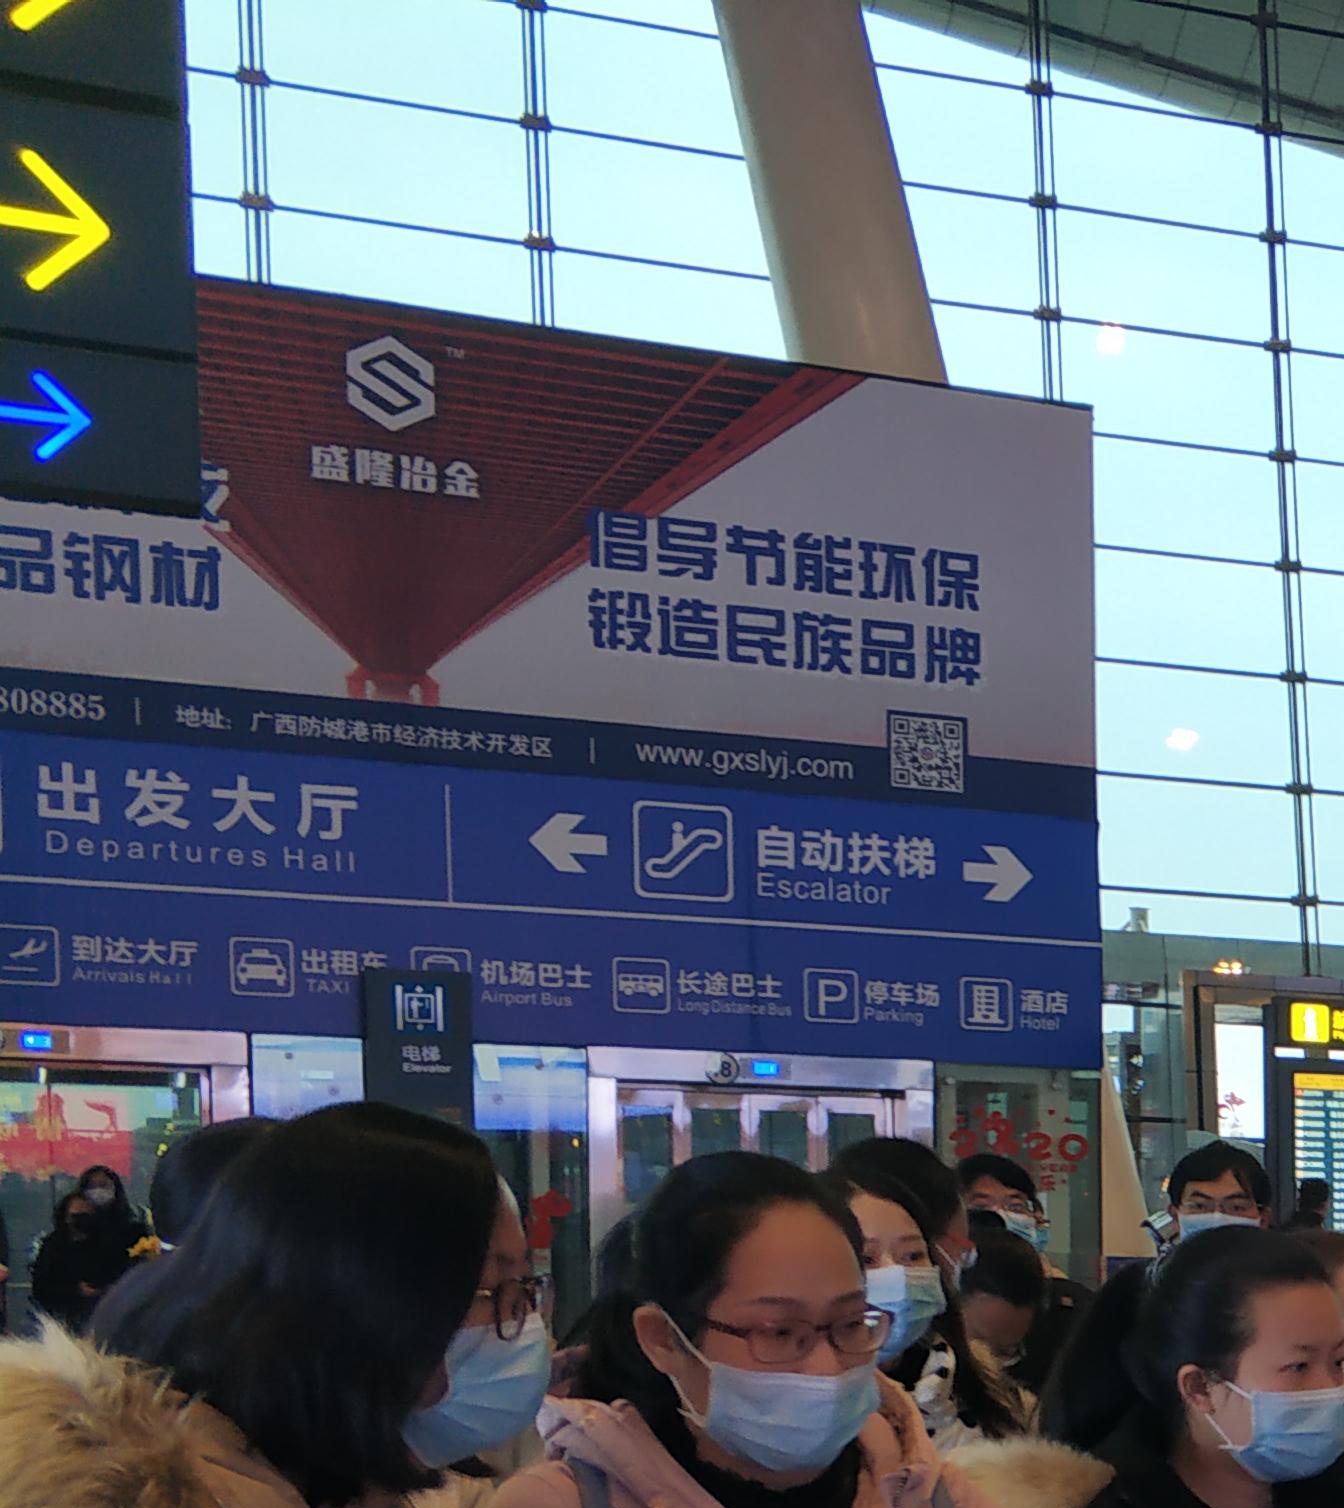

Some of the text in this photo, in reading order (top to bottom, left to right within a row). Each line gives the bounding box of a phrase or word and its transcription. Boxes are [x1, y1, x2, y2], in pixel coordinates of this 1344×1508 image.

[310, 444, 481, 499] 盛隆冶金
[0, 523, 222, 611] 品钢材
[588, 508, 981, 612] 倡导节能环保
[587, 588, 982, 687] 锻造民族品牌
[635, 741, 855, 781] www.gxslyj.com
[36, 760, 360, 841] 出发大厅
[45, 829, 357, 874] Departures Hall
[756, 824, 937, 880] 自动扶梯
[756, 873, 892, 906] Escalator
[71, 934, 200, 967] 到达大厅
[301, 948, 389, 977] 出租车
[72, 967, 193, 985] Arrivals Hall
[305, 977, 350, 995] TAXI
[479, 958, 593, 989] 机场巴士
[676, 969, 784, 1000] 长途巴士
[479, 990, 574, 1009] Airport Bus
[677, 999, 792, 1018] Long Distance Bus
[864, 980, 941, 1008] 停车场
[1019, 988, 1069, 1016] 酒店
[863, 1006, 925, 1027] Parking
[1019, 1015, 1061, 1032] Hotel
[401, 1045, 442, 1063] 电梯
